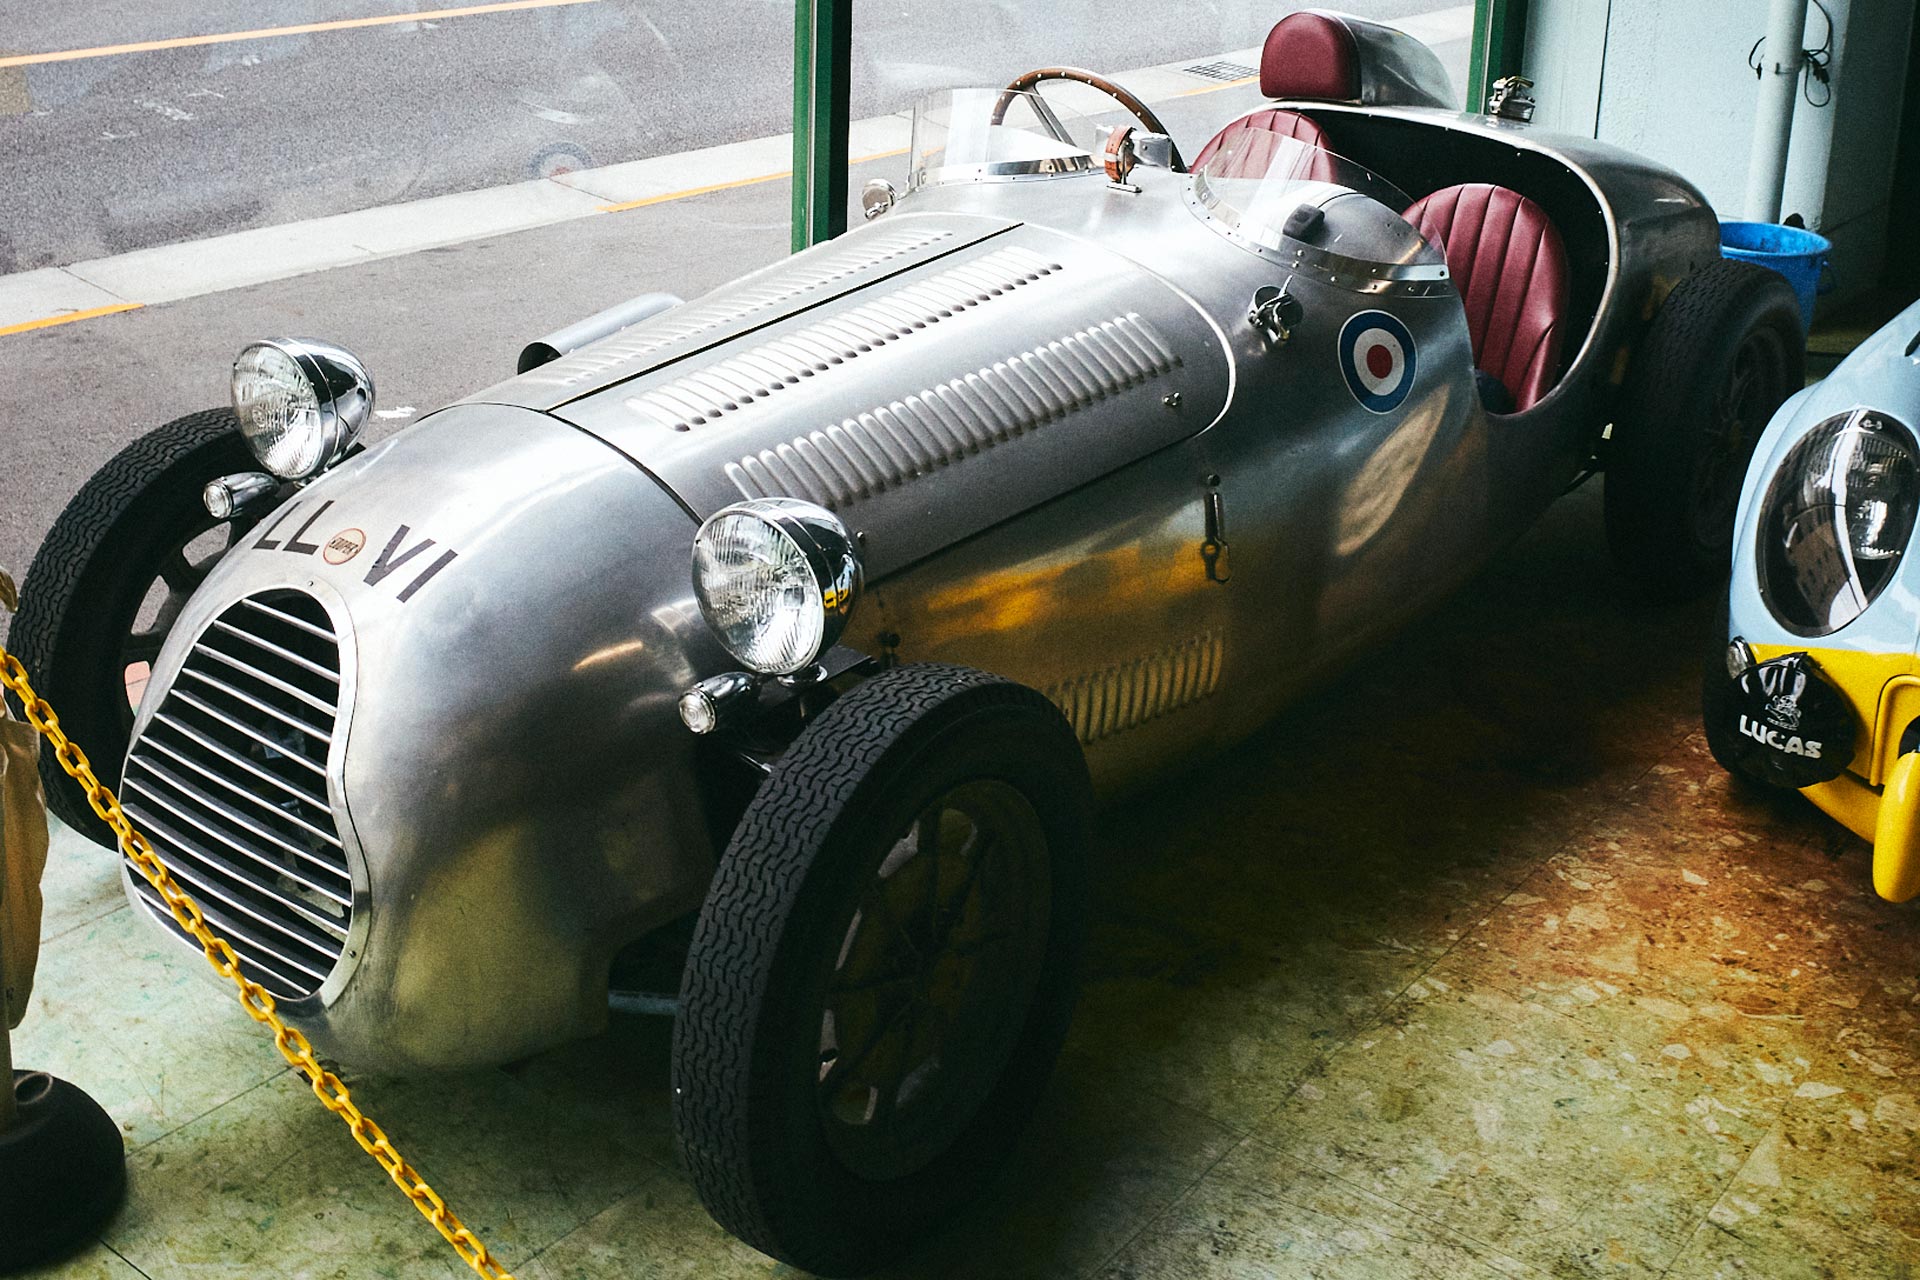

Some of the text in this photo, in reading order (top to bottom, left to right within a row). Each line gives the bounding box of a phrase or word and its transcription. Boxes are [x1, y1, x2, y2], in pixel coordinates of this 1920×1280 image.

[252, 500, 458, 603] LL VI
[1739, 714, 1823, 759] LUCAS
